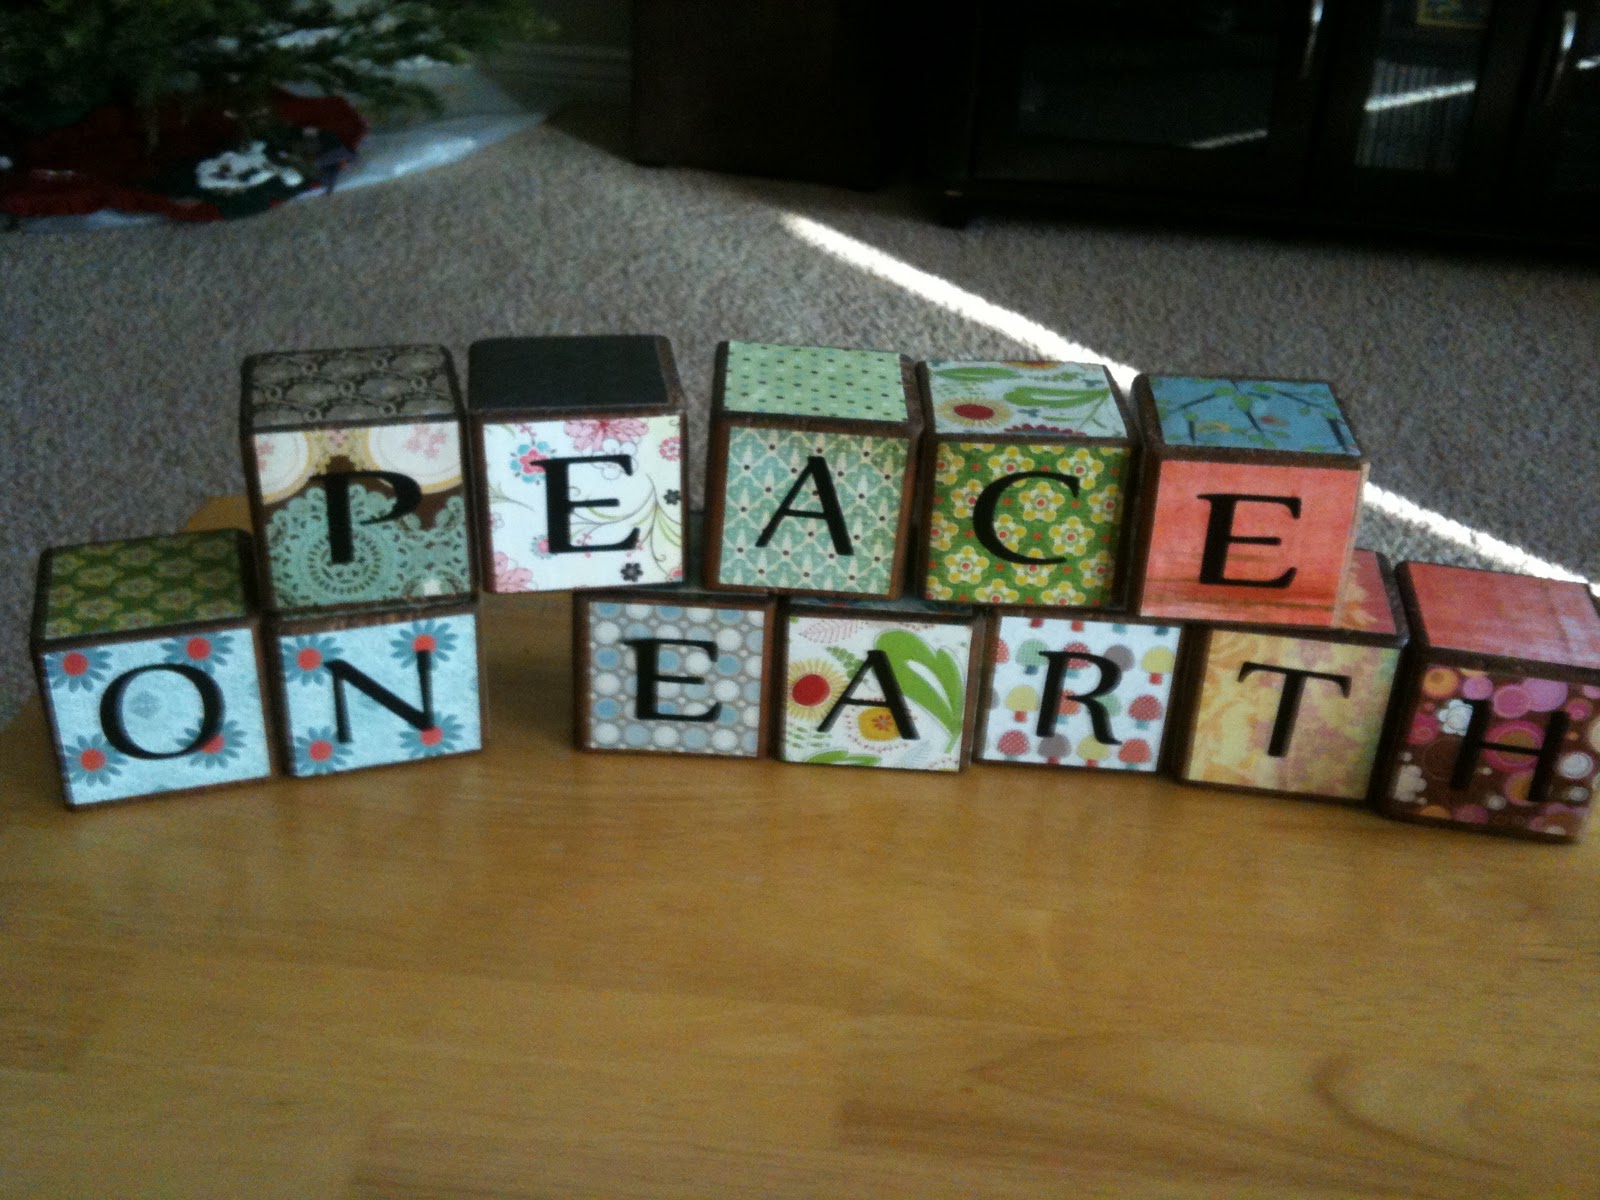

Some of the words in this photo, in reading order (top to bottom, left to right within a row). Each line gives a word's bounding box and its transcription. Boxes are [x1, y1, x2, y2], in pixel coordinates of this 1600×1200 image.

[311, 453, 1302, 590] PEACE
[100, 648, 437, 760] ON
[623, 638, 1569, 801] EARTH
